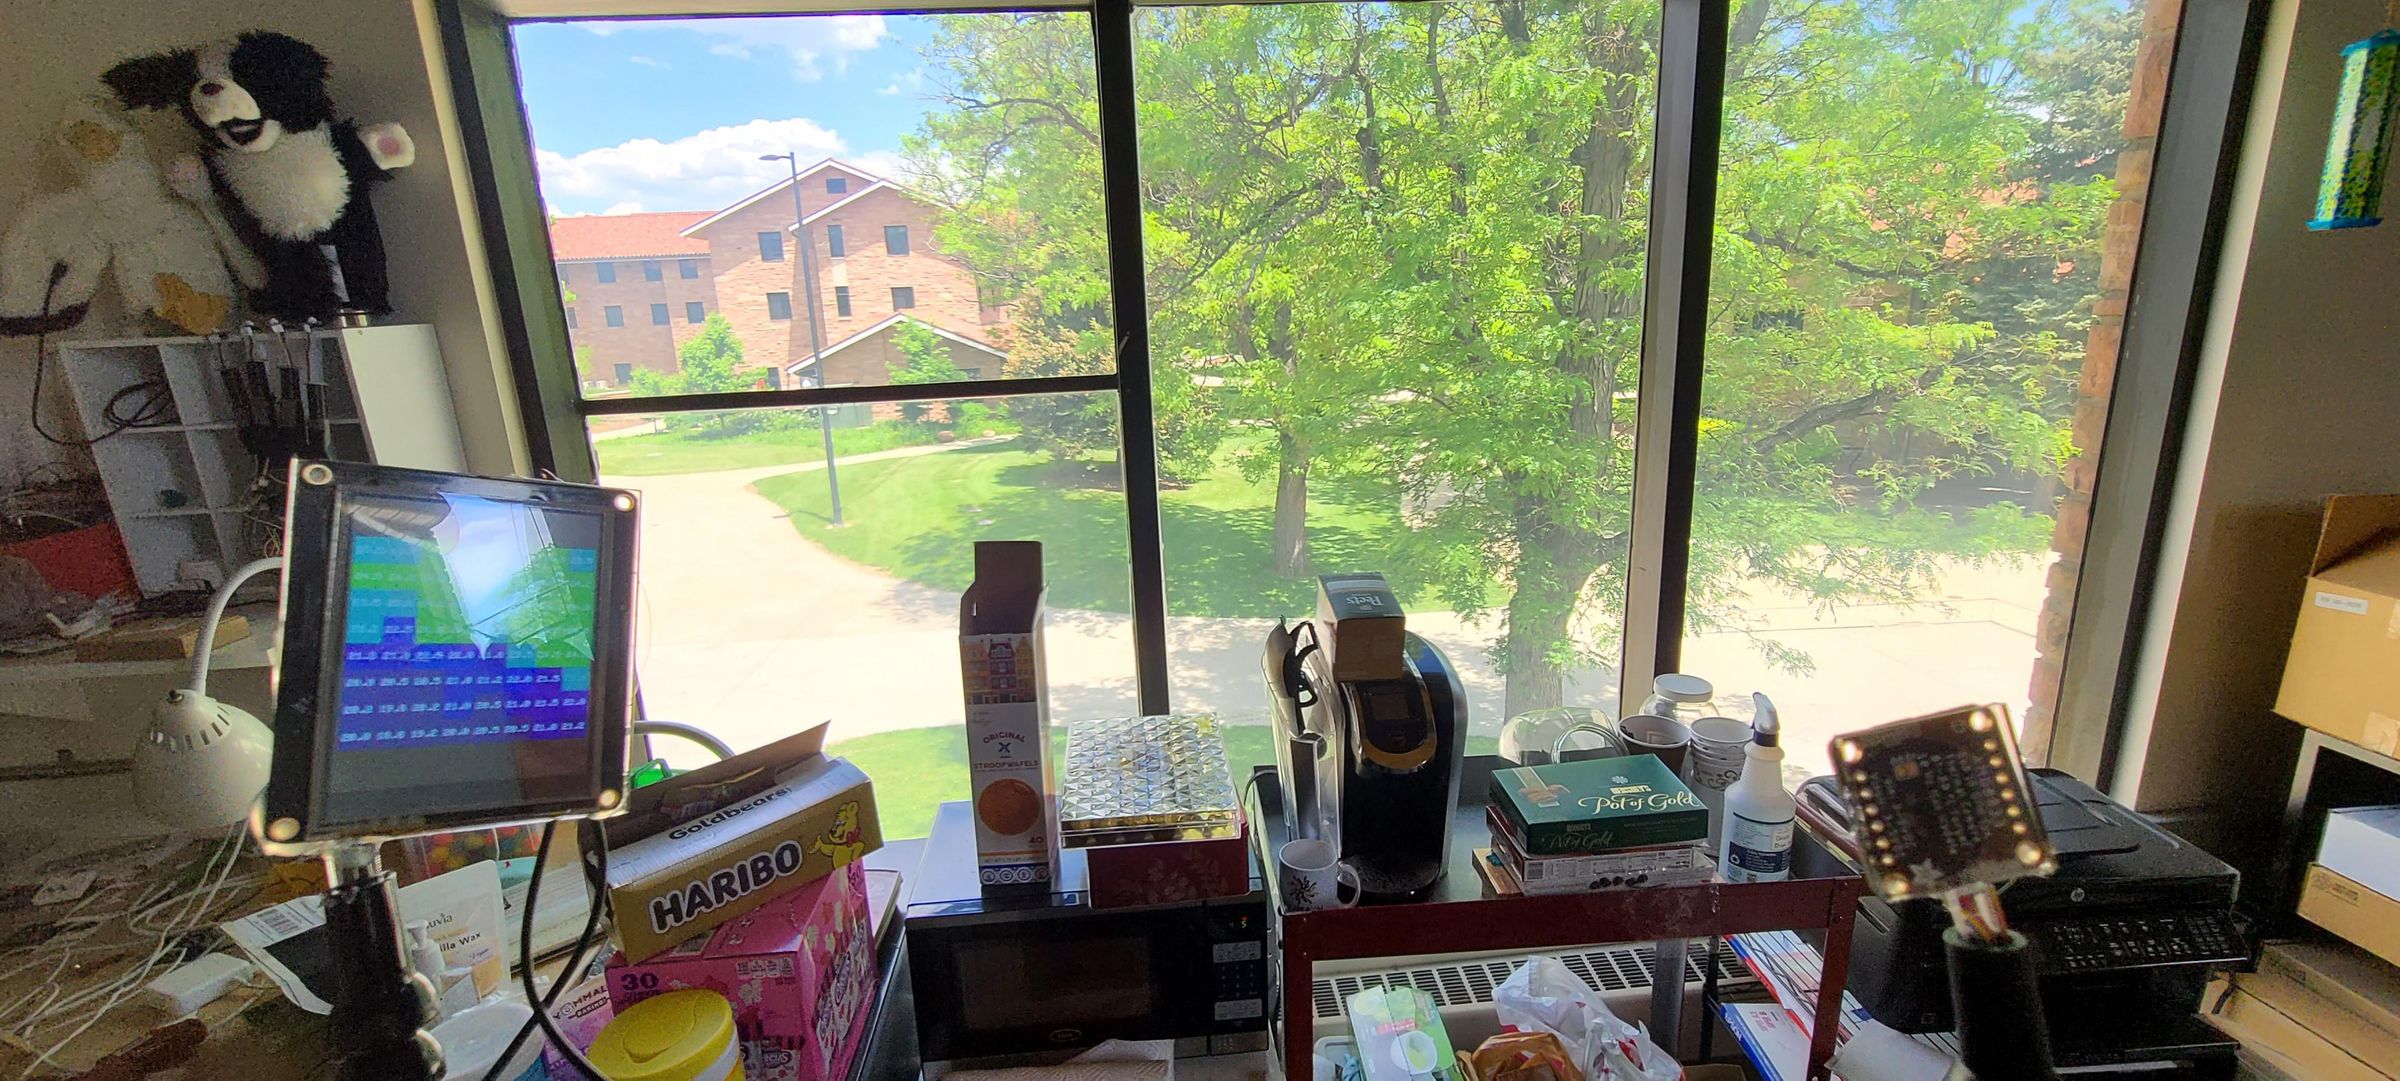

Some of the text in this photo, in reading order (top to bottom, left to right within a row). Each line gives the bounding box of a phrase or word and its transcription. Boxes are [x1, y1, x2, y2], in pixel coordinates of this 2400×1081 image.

[983, 731, 1026, 744] ORIGINAL
[974, 760, 1039, 769] STROOPWAFELS
[1578, 791, 1701, 815] Pot of Gold
[668, 787, 789, 842] Goldbears
[650, 841, 803, 933] HARIBO
[427, 912, 454, 929] uvia
[458, 931, 481, 947] Wax
[620, 972, 660, 991] 30
